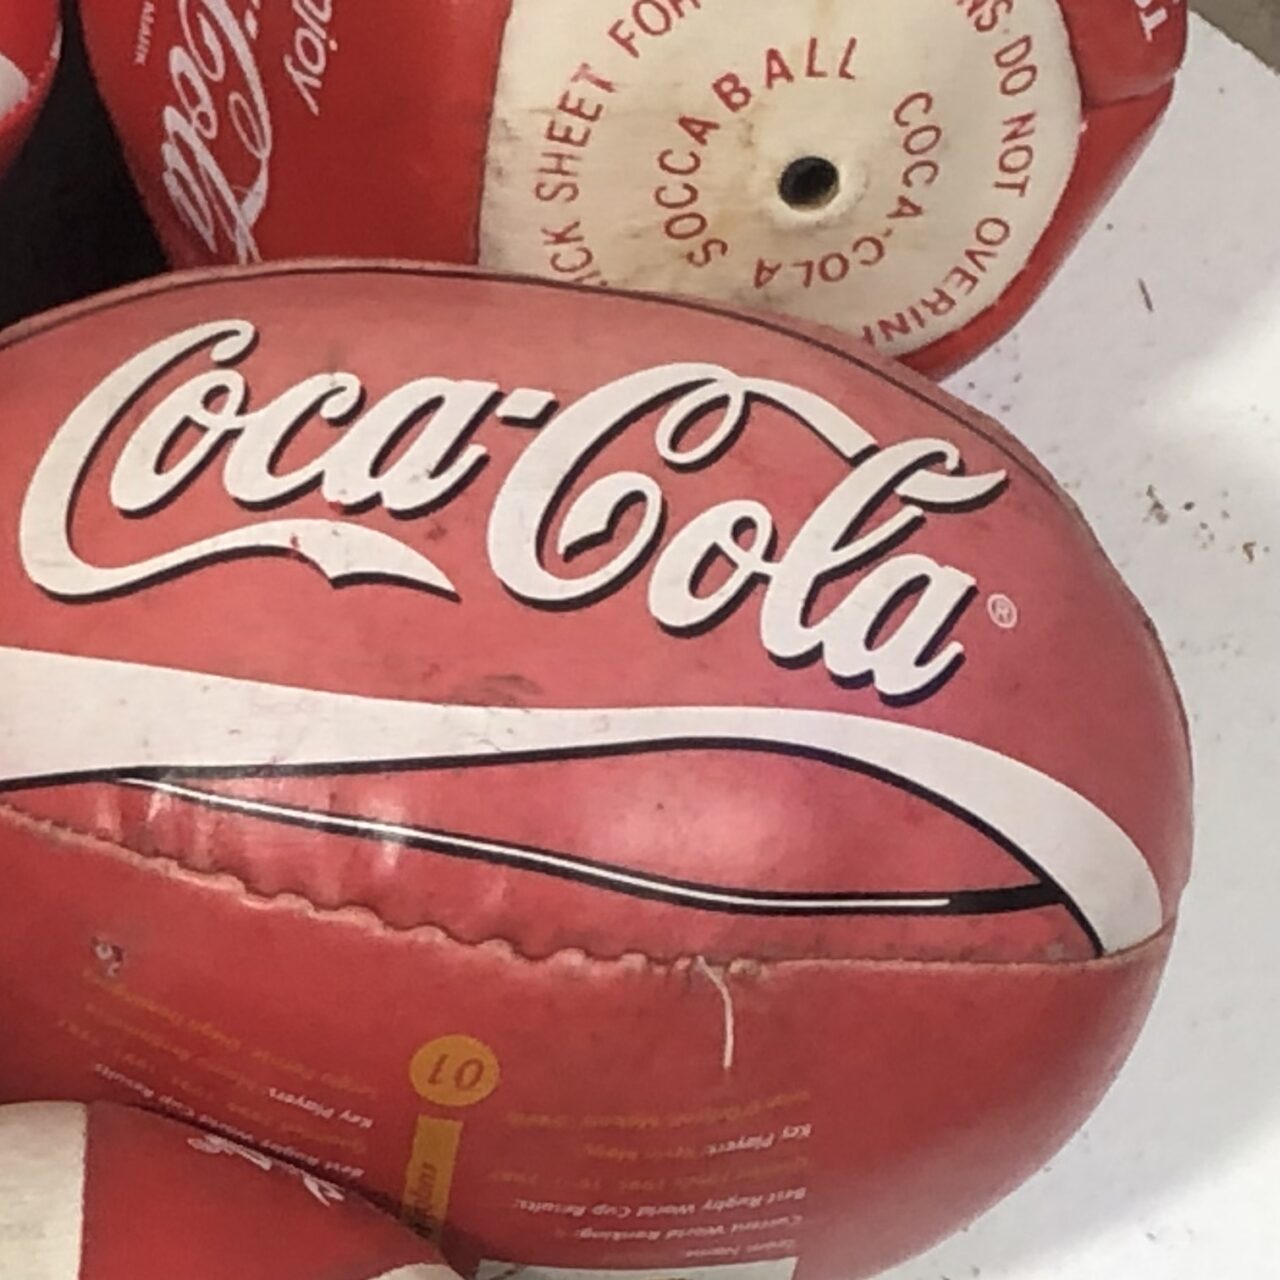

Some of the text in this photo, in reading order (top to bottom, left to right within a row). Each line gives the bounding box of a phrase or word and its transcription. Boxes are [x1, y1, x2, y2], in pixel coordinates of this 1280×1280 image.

[161, 0, 272, 264] -Cola
[535, 62, 618, 203] SHEET
[994, 34, 1039, 97] DO
[654, 36, 858, 268] SOCCA BALL
[753, 91, 943, 290] COCA-COLA
[993, 111, 1037, 198] NOT
[19, 319, 1008, 698] Coca-Cola
[590, 1203, 633, 1220] Cup
